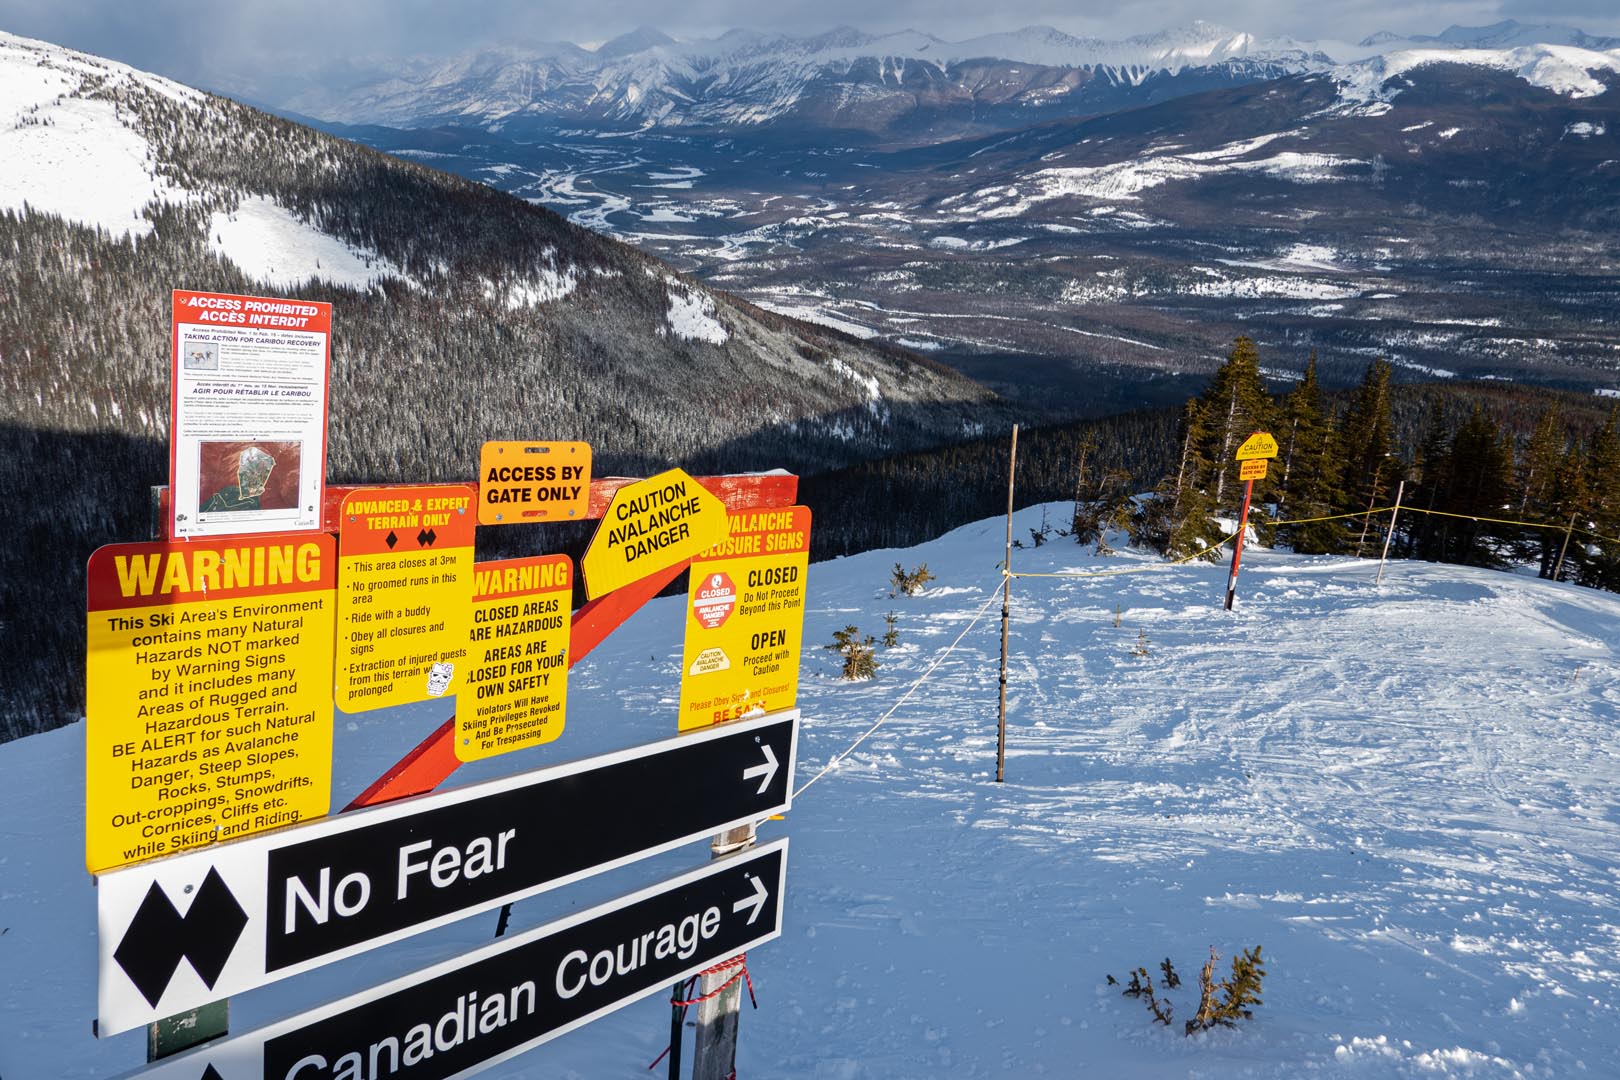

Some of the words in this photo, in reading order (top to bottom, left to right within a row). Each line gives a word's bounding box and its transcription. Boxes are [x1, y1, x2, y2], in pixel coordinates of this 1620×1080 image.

[188, 297, 241, 310] ACCESS
[245, 302, 318, 316] PROHIBITED
[250, 314, 308, 327] INTERDIT
[487, 467, 555, 482] ACCESS
[562, 466, 583, 480] BY
[346, 500, 409, 514] ADVANCED
[427, 497, 470, 510] EXPERT
[488, 487, 532, 503] GATE
[538, 487, 581, 501] ONLY
[617, 482, 686, 520] CAUTION
[367, 515, 418, 530] TERRAIN
[423, 514, 450, 526] ONLY
[608, 497, 701, 548] AVALANCHE
[625, 523, 690, 562] DANGER
[766, 532, 803, 552] SIGNS
[115, 543, 321, 597] WARNING
[354, 562, 372, 572] This
[376, 561, 395, 571] area
[399, 557, 426, 568] closes
[430, 557, 437, 566] at
[441, 556, 456, 565] 3PM
[353, 582, 364, 591] No
[368, 578, 407, 592] groomed
[410, 576, 428, 586] runs
[432, 574, 438, 584] in
[442, 573, 456, 582] this
[474, 562, 567, 596] WARNING
[748, 567, 797, 587] CLOSED
[352, 595, 372, 604] area
[701, 588, 730, 598] CLOSED
[744, 593, 753, 602] Do
[756, 591, 768, 600] Not
[771, 587, 799, 599] Proceed
[108, 617, 144, 632] This
[149, 613, 175, 626] Ski
[180, 609, 227, 624] Area's
[233, 599, 323, 618] Environment
[352, 612, 372, 623] Ride
[375, 610, 393, 620] with
[405, 606, 430, 617] buddy
[475, 605, 518, 623] CLOSED
[523, 600, 558, 616] AREAS
[699, 604, 729, 613] AVALANCHE
[703, 611, 724, 619] DANGER
[740, 604, 765, 616] Beyond
[768, 602, 780, 611] this
[784, 599, 800, 608] Point
[132, 630, 201, 647] contains
[207, 624, 248, 640] many
[253, 616, 303, 632] Natural
[351, 631, 373, 642] Obey
[377, 629, 387, 638] all
[390, 625, 426, 637] closures
[429, 621, 444, 632] and
[470, 627, 491, 641] ARE
[496, 616, 562, 637] HAZARDOUS
[136, 646, 202, 664] Hazards
[208, 640, 241, 655] NOT
[246, 634, 299, 651] marked
[351, 644, 374, 656] signs
[751, 629, 786, 650] OPEN
[350, 659, 394, 673] Extraction
[398, 656, 406, 666] of
[409, 652, 437, 665] injured
[441, 649, 466, 662] guests
[484, 645, 521, 662] AREAS
[526, 640, 547, 655] ARE
[696, 657, 724, 666] AVALANCHE
[744, 654, 772, 666] Proceed
[775, 650, 789, 659] with
[152, 668, 170, 681] by
[176, 658, 240, 677] Warning
[246, 652, 285, 668] Signs
[511, 660, 532, 675] FOR
[537, 655, 563, 670] YOUR
[700, 663, 719, 671] DANGER
[753, 663, 779, 676] Caution
[139, 685, 168, 700] and
[174, 683, 184, 694] it
[189, 673, 253, 693] includes
[258, 668, 295, 683] many
[349, 675, 370, 685] from
[374, 671, 389, 682] this
[393, 667, 420, 679] terrain
[477, 682, 504, 699] OWN
[509, 674, 549, 692] SAFETY
[137, 701, 184, 718] Areas
[189, 696, 204, 709] of
[210, 684, 266, 706] Rugged
[272, 682, 297, 695] and
[349, 683, 392, 700] prolonged
[690, 700, 711, 711] Please
[714, 696, 729, 706] Obey
[750, 689, 761, 698] and
[763, 683, 789, 696] Closures!
[477, 703, 511, 716] Violators
[514, 698, 528, 708] Will
[531, 695, 548, 704] Have
[145, 711, 229, 734] Hazardous
[235, 702, 289, 719] Terrain.
[463, 719, 487, 731] Skiing
[490, 710, 527, 725] Privileges
[530, 703, 560, 716] Revoked
[476, 731, 490, 739] And
[506, 716, 547, 732] Prosecuted
[713, 710, 730, 724] BE
[113, 743, 135, 757] BE
[141, 733, 196, 752] ALERT
[201, 729, 221, 741] for
[226, 722, 261, 737] such
[266, 712, 315, 730] Natural
[482, 741, 494, 749] For
[497, 730, 541, 745] Trespassing
[132, 750, 197, 771] Hazards
[203, 747, 220, 758] as
[225, 731, 298, 754] Avalanche
[132, 769, 193, 789] Danger,
[199, 759, 242, 776] Steep
[247, 748, 298, 766] Slopes,
[159, 781, 210, 800] Rocks,
[217, 769, 275, 788] Stumps,
[112, 795, 229, 827] Out-croppings,
[235, 777, 313, 800] Snowdrifts,
[142, 816, 215, 838] Cornices,
[222, 801, 258, 820] Cliffs
[263, 798, 287, 810] etc.
[124, 842, 165, 859] while
[171, 830, 217, 848] Skiing
[223, 821, 249, 835] and
[255, 810, 302, 827] Riding.
[284, 868, 370, 935] No
[398, 828, 516, 901] Fear
[556, 905, 720, 1000] Courage
